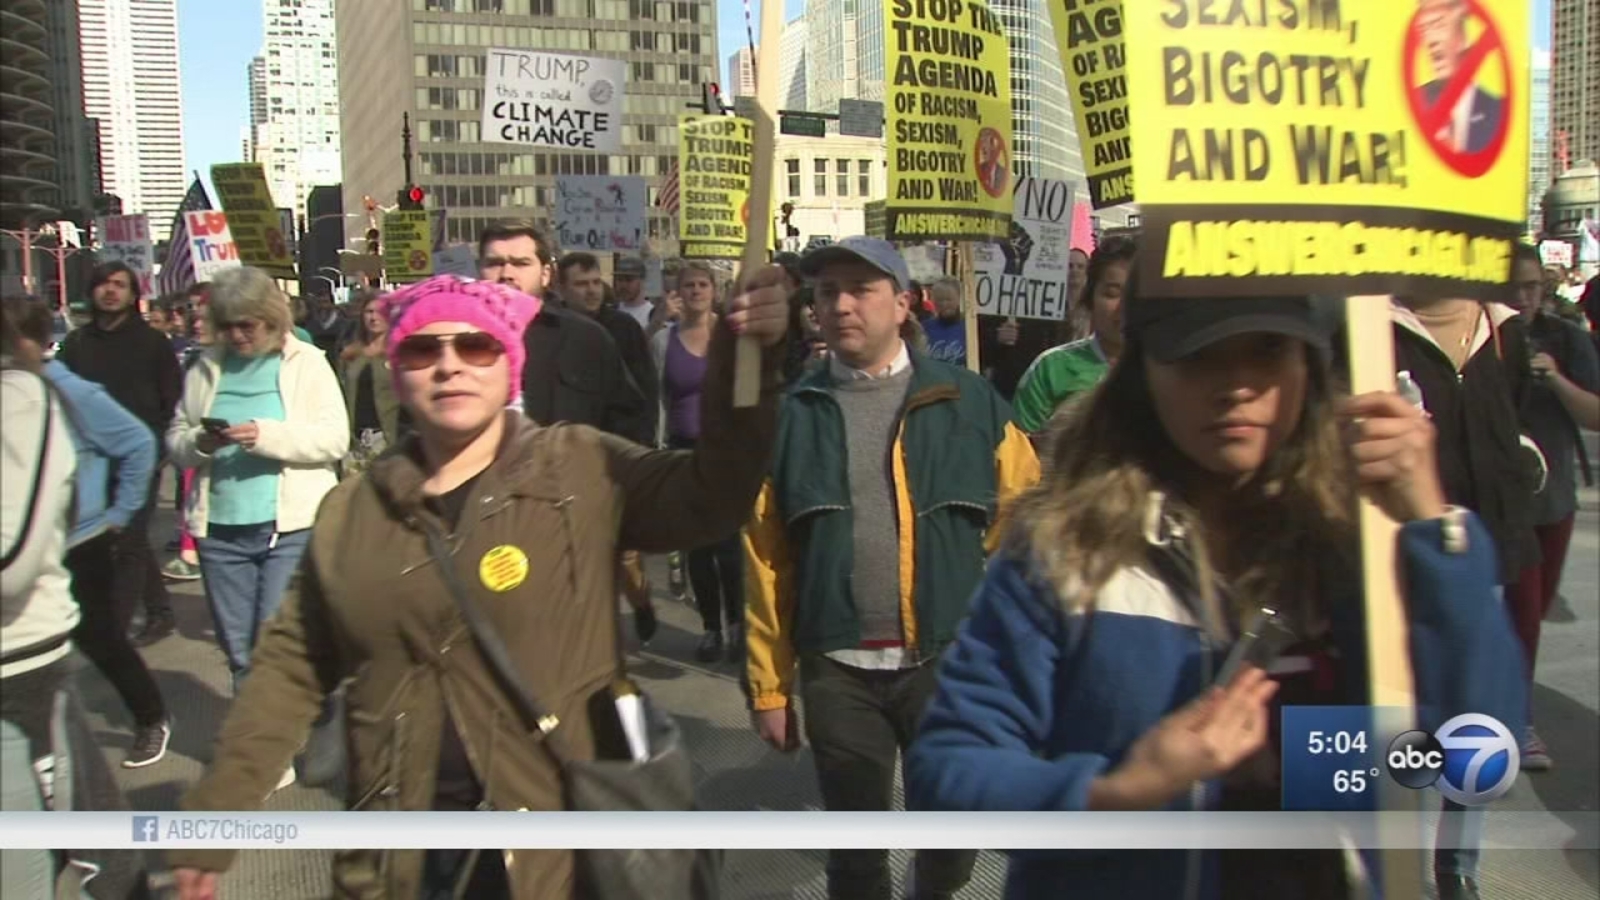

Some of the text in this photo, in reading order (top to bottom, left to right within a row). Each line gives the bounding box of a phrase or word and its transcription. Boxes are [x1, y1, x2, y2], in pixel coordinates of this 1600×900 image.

[892, 0, 962, 23] STOP
[1068, 4, 1125, 49] AG
[892, 20, 984, 60] TRUMP
[493, 52, 590, 87] TRUMP,
[893, 54, 997, 98] AGENDA
[1073, 50, 1098, 77] OF
[1162, 46, 1370, 108] BIGOTRY
[496, 83, 571, 101] this is called
[1079, 75, 1127, 108] SEXI
[492, 101, 609, 132] CLIMATE
[895, 92, 982, 125] OF RACISM,
[1085, 104, 1130, 138] BIG
[501, 124, 595, 149] CHANGE
[684, 117, 755, 139] STOP T
[895, 118, 962, 150] SEXISM,
[684, 135, 753, 157] TRUMP
[896, 147, 967, 174] BIGOTRY
[1166, 124, 1408, 189] AND WAR!
[684, 154, 752, 176] AGEND
[684, 175, 699, 187] OF
[896, 177, 979, 203] AND WAR!
[685, 206, 736, 221] BIGOTRY
[1024, 177, 1067, 222] NO
[685, 223, 711, 236] AND
[997, 274, 1065, 318] HATE!
